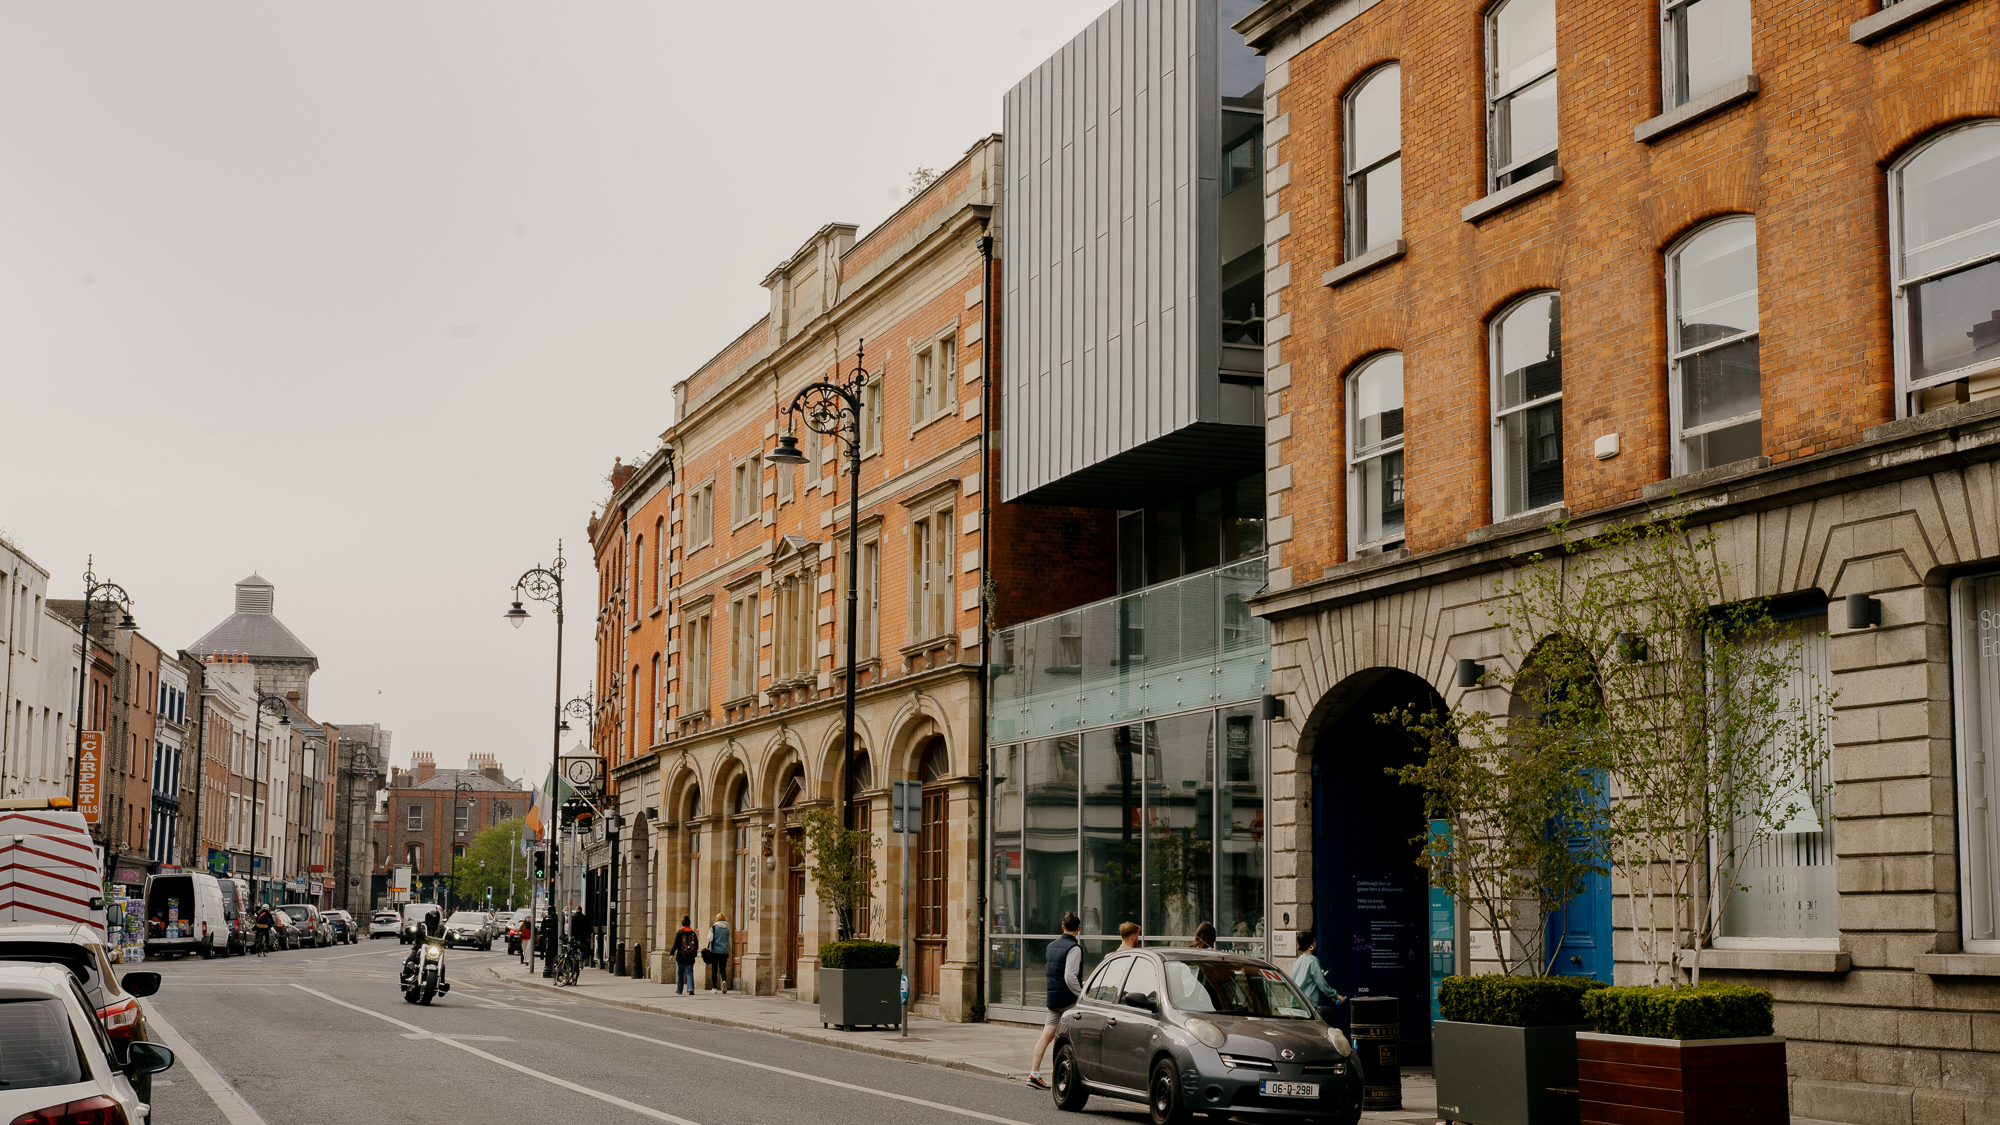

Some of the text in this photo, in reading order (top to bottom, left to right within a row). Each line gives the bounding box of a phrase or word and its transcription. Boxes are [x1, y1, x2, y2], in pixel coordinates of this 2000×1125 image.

[1777, 639, 1790, 660] of
[79, 741, 97, 803] CARPET
[1262, 970, 1282, 981] N
[1272, 1084, 1313, 1095] 06-D-2981
